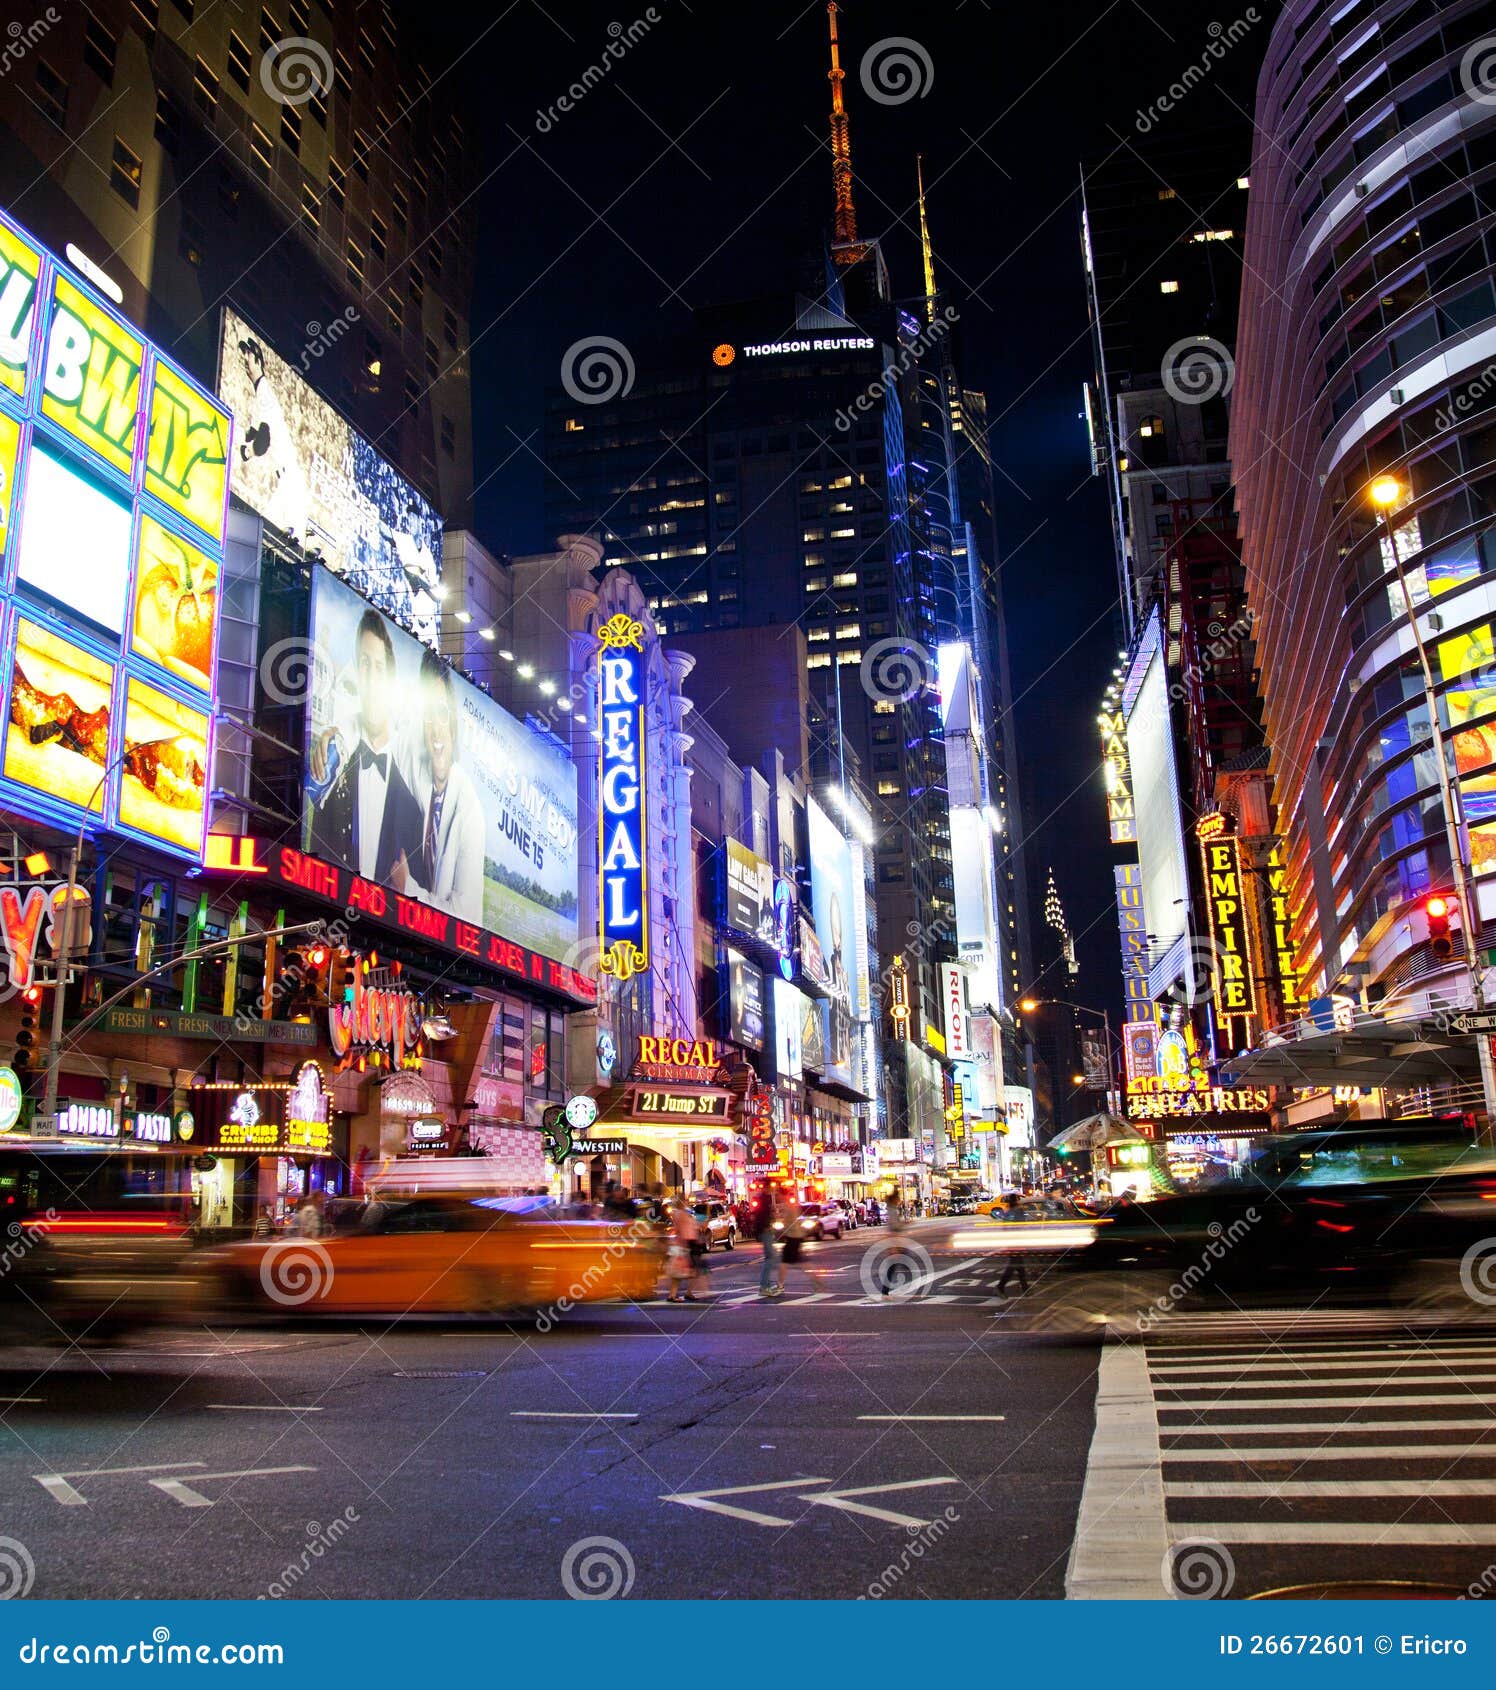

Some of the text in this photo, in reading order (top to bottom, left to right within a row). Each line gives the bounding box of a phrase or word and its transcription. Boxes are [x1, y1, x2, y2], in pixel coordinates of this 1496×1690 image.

[744, 338, 874, 357] THOMSON REUTERS
[0, 250, 225, 498] UBWAY
[463, 697, 485, 724] ADAM
[1102, 713, 1133, 841] MADAME
[601, 658, 640, 927] REGAL
[497, 809, 544, 870] JUNE 15
[280, 847, 339, 899] SMITH
[348, 876, 386, 918] AND
[395, 895, 450, 942] TOMMY
[456, 921, 480, 956] LEE
[531, 954, 543, 982] IN
[1211, 845, 1247, 1007] EMPIRE
[111, 1011, 145, 1028] FRESH
[178, 1017, 208, 1032] FRESH
[238, 1022, 265, 1037] FRESH
[948, 970, 962, 1052] RICOH
[1458, 1019, 1478, 1029] ONE
[639, 1035, 720, 1068] REGAL
[648, 1065, 713, 1081] CINEMAS
[1127, 1072, 1190, 1094] amc
[642, 1093, 717, 1113] 21 Jump ST
[1127, 1089, 1269, 1119] THEATRES
[36, 1120, 54, 1130] WAIT
[136, 1113, 171, 1142] PASTA
[219, 1125, 279, 1136] CRUMBS
[220, 1136, 277, 1144] BAKE SHOP
[580, 1142, 624, 1153] WESTIN
